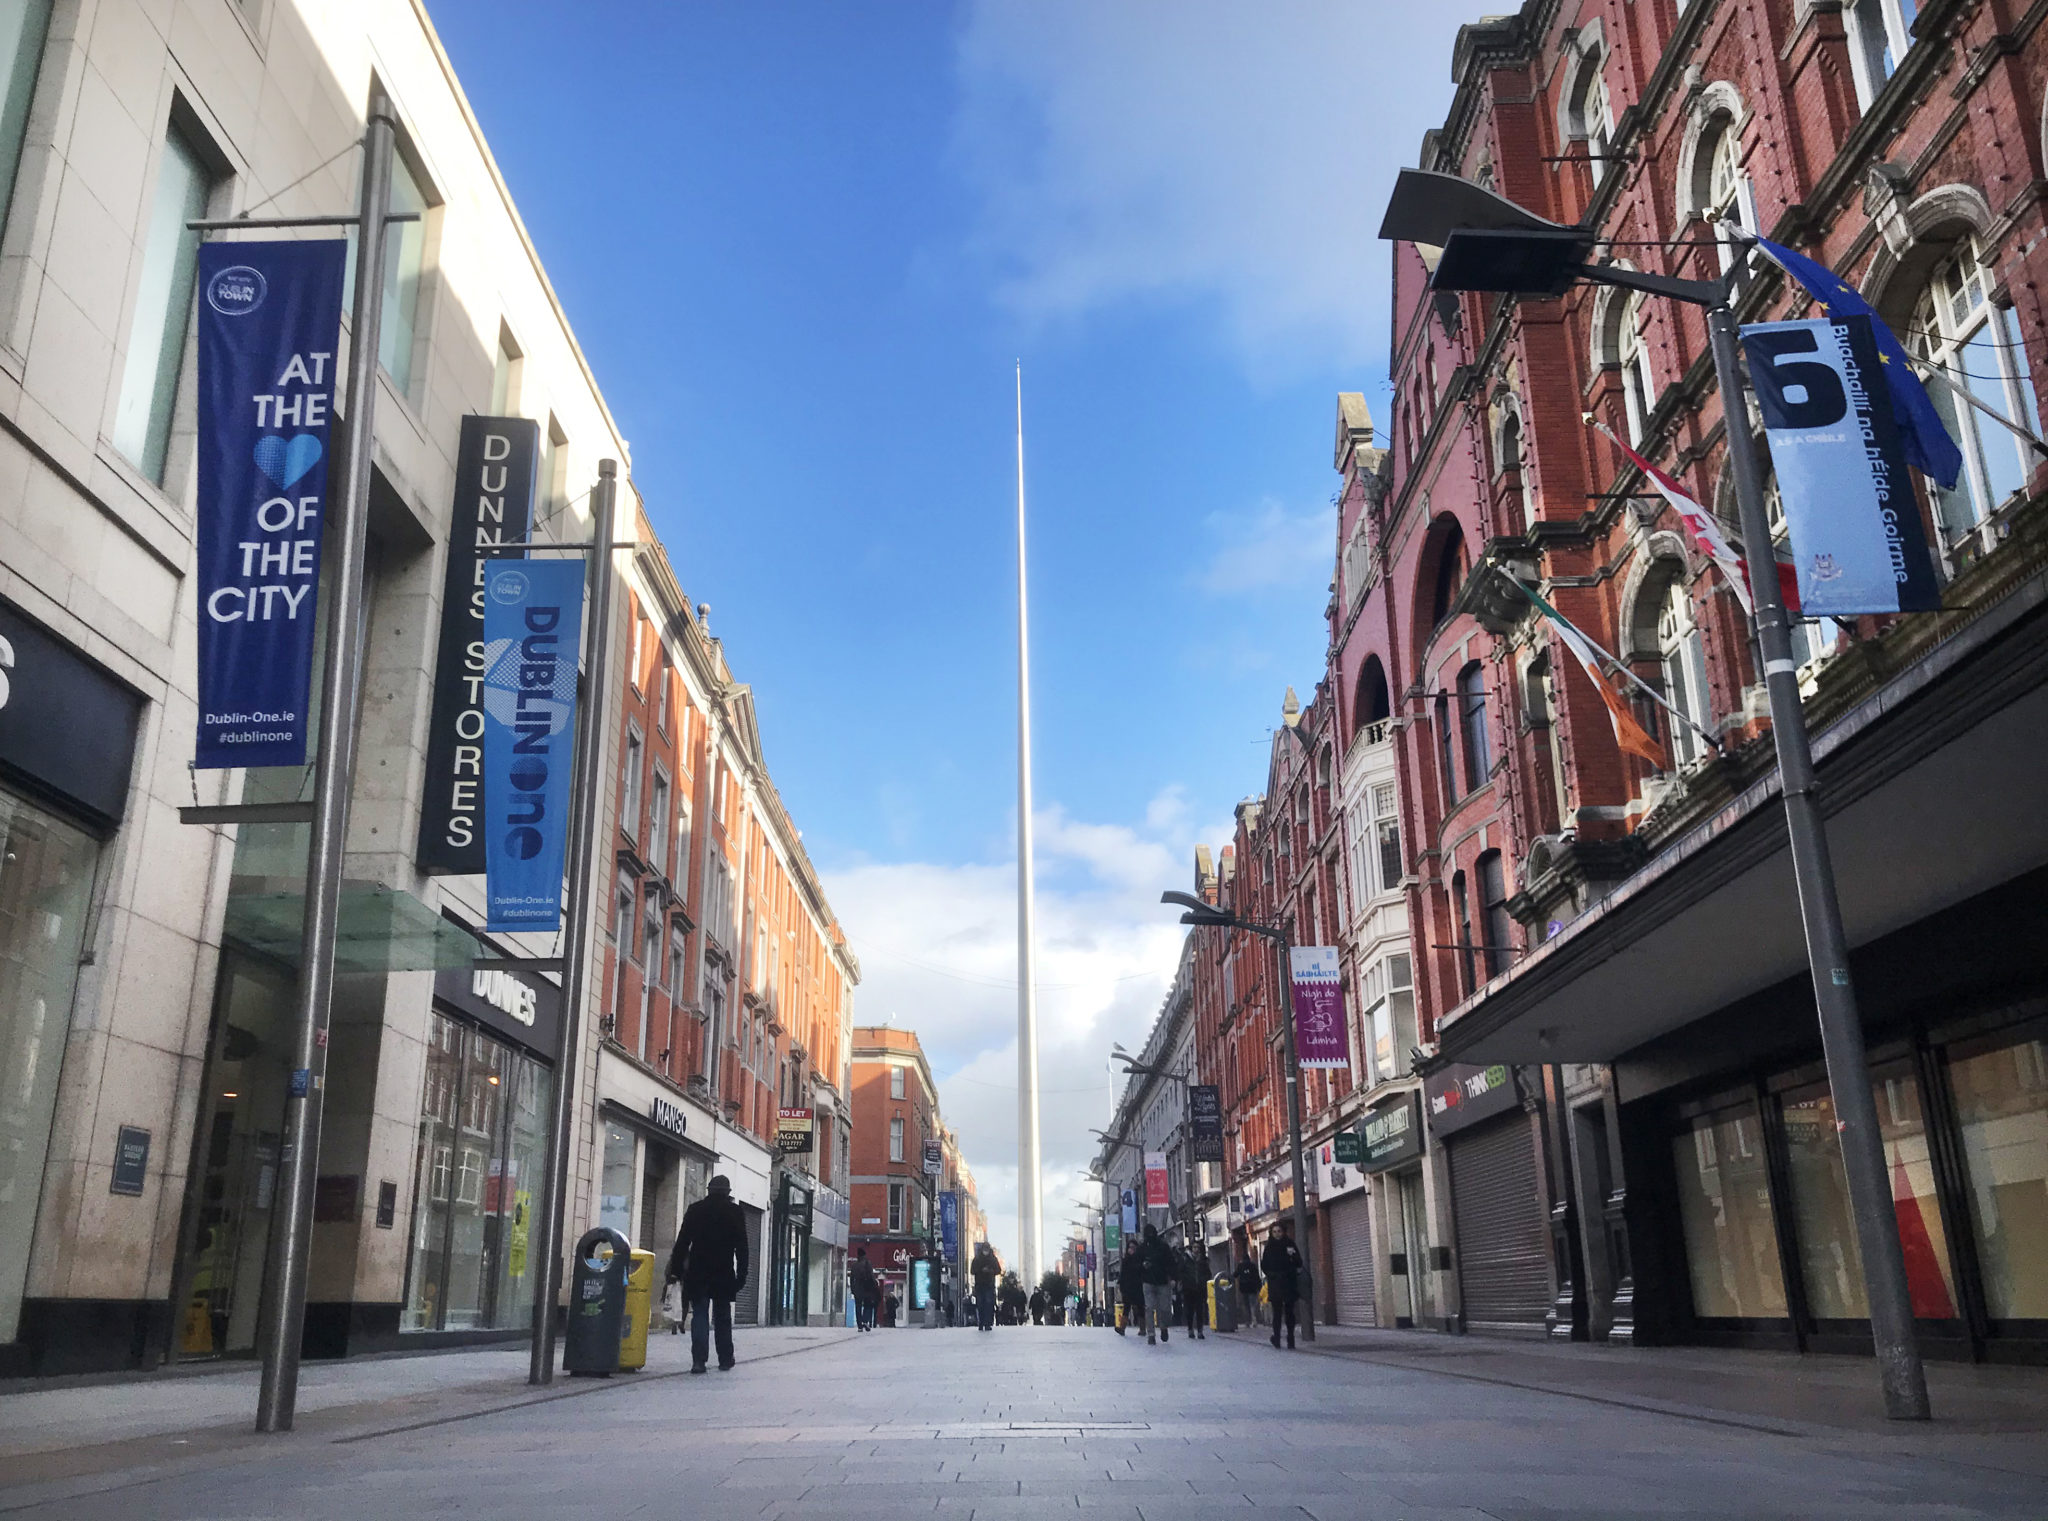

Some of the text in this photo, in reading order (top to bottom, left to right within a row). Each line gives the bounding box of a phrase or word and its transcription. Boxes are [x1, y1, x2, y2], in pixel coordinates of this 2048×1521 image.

[218, 290, 252, 302] TOWN
[277, 352, 331, 386] AT
[1833, 324, 1868, 413] Buachaillí
[253, 393, 327, 428] THE
[1858, 416, 1873, 442] na
[1863, 446, 1890, 501] hÉide
[256, 496, 319, 532] OF
[238, 540, 315, 576] THE
[207, 584, 311, 623] CITY
[205, 710, 295, 725] Dublin-One.ie
[219, 731, 293, 743] #dublinone
[446, 641, 484, 848] STORES
[473, 969, 536, 1027] DUNNES
[1301, 988, 1335, 1000] Nigh do
[654, 1097, 687, 1136] MANGO
[791, 1110, 805, 1118] LET
[779, 1132, 805, 1141] AGAR
